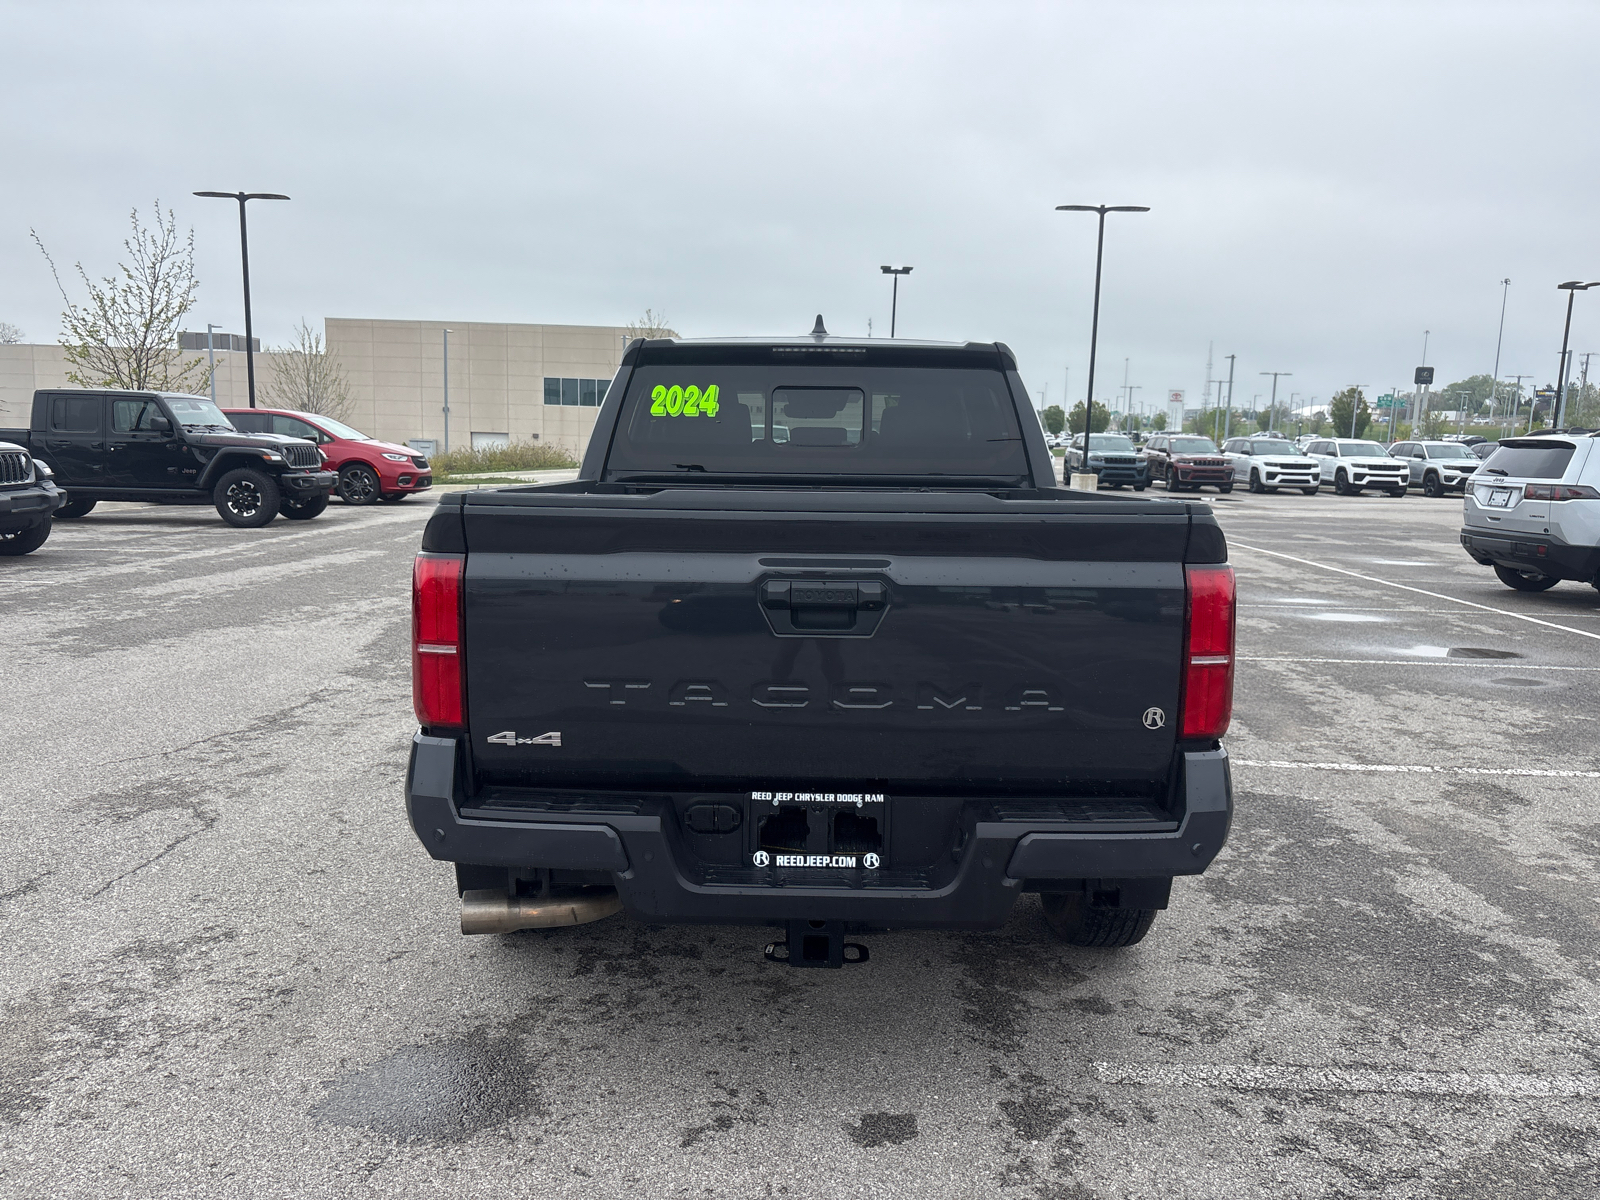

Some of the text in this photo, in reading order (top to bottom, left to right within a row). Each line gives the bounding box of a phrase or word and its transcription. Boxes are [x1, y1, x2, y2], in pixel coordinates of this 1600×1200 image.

[650, 384, 719, 417] 2024
[794, 590, 854, 602] TOYOTA
[583, 677, 1064, 711] TACOMA
[751, 791, 884, 803] REED JEEP CHRYSLER DODGE RAM
[776, 855, 856, 868] REEDJEEP.COM
